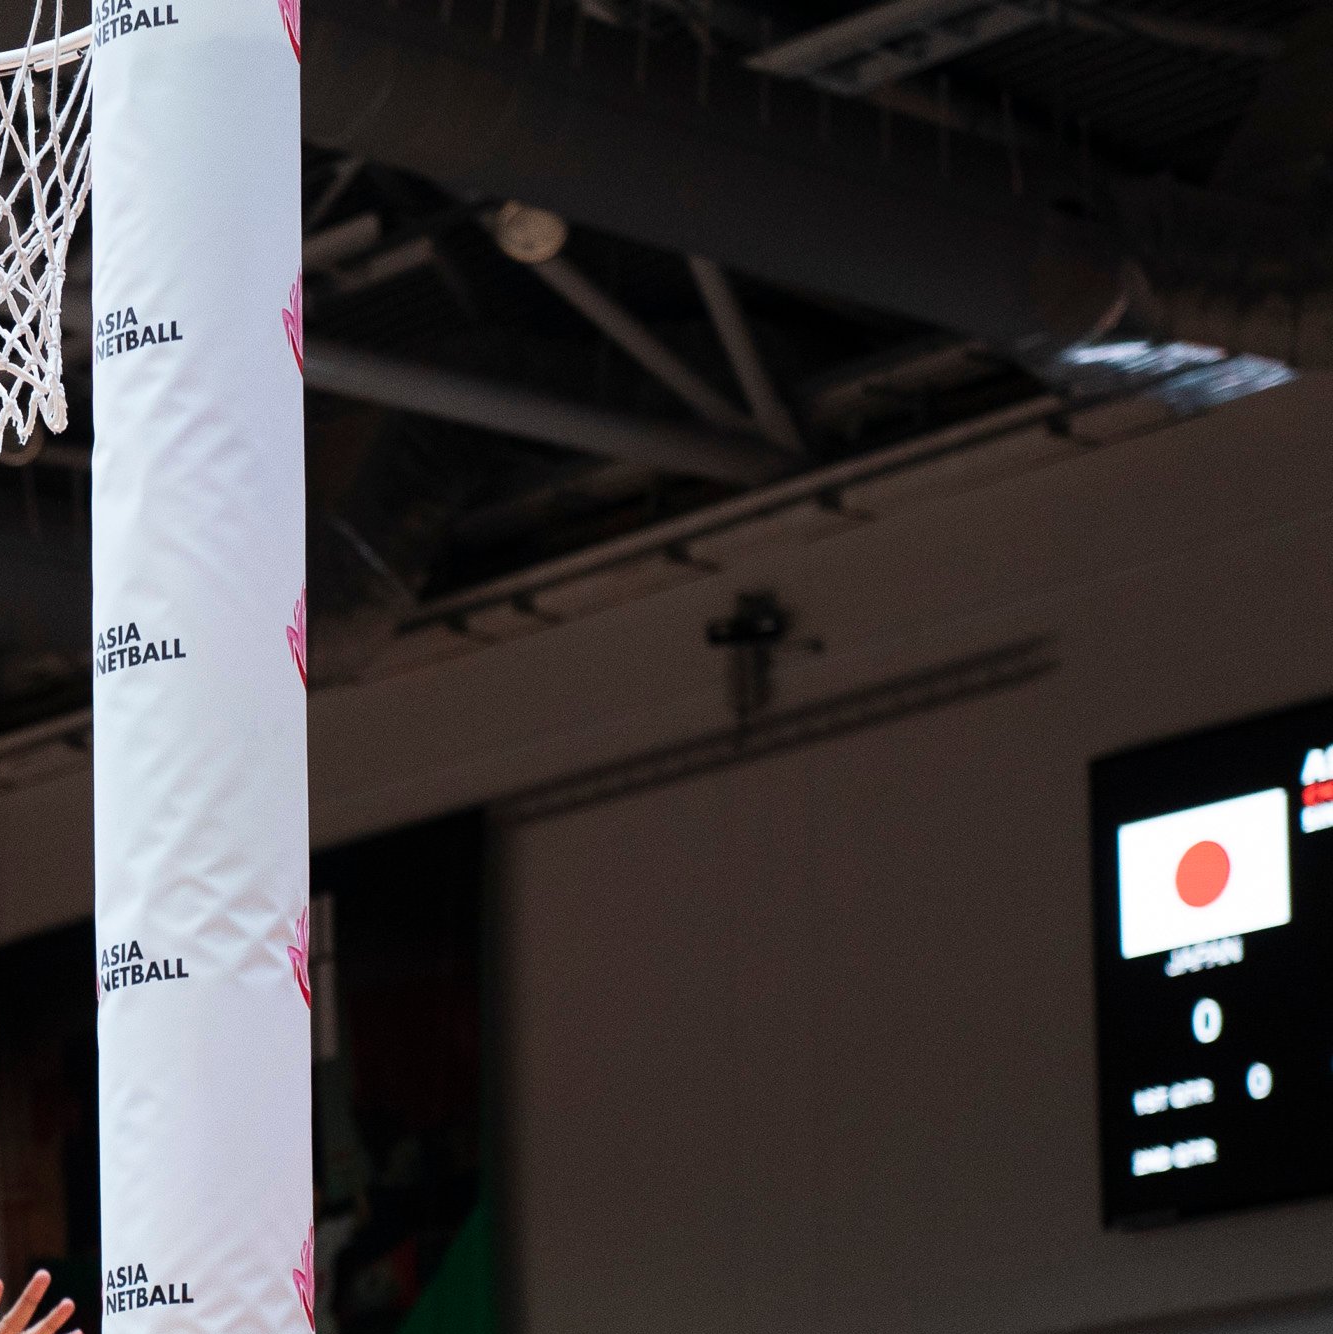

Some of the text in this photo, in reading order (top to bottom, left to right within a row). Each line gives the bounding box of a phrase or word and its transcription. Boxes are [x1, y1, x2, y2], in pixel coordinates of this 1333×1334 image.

[94, 4, 179, 51] NETBALL
[95, 306, 139, 338] ASIA
[94, 320, 183, 364] NETBALL
[96, 622, 142, 654] ASIA
[95, 638, 187, 677] NETBALL
[100, 940, 144, 969] ASIA
[100, 957, 190, 993] NETBALL
[1192, 997, 1223, 1044] 0
[1246, 1061, 1273, 1101] 0
[106, 1263, 149, 1292] ASIA
[105, 1282, 195, 1316] NETBALL
